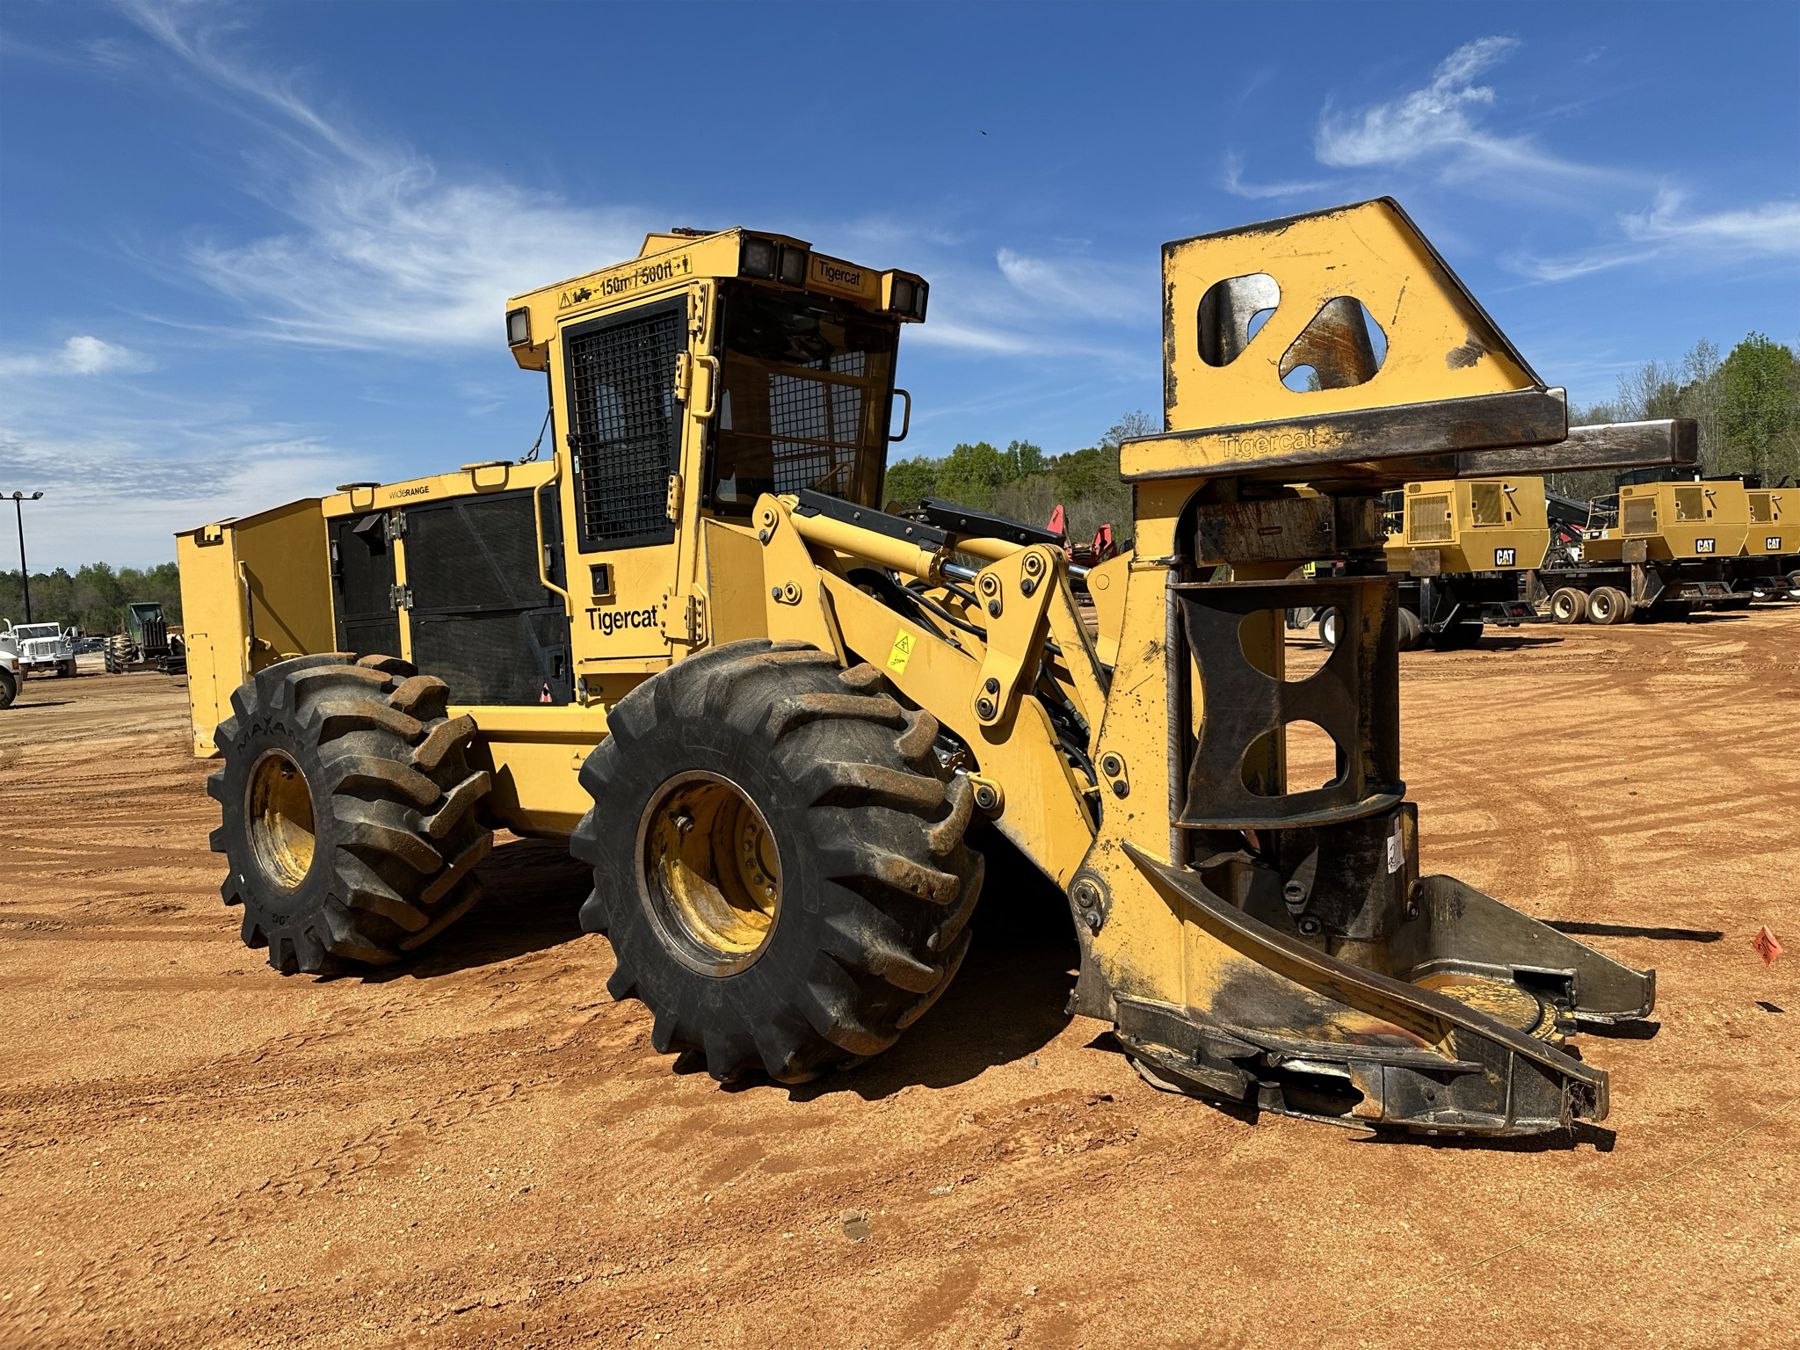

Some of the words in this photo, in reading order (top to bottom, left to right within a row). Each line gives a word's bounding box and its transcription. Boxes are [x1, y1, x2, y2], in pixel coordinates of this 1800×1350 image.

[819, 260, 860, 286] Tigercat
[1220, 428, 1316, 460] Tigercat
[1697, 539, 1714, 554] CAT
[1767, 538, 1780, 550] CAT
[1496, 549, 1514, 565] CAT
[585, 604, 658, 636] Tigercat
